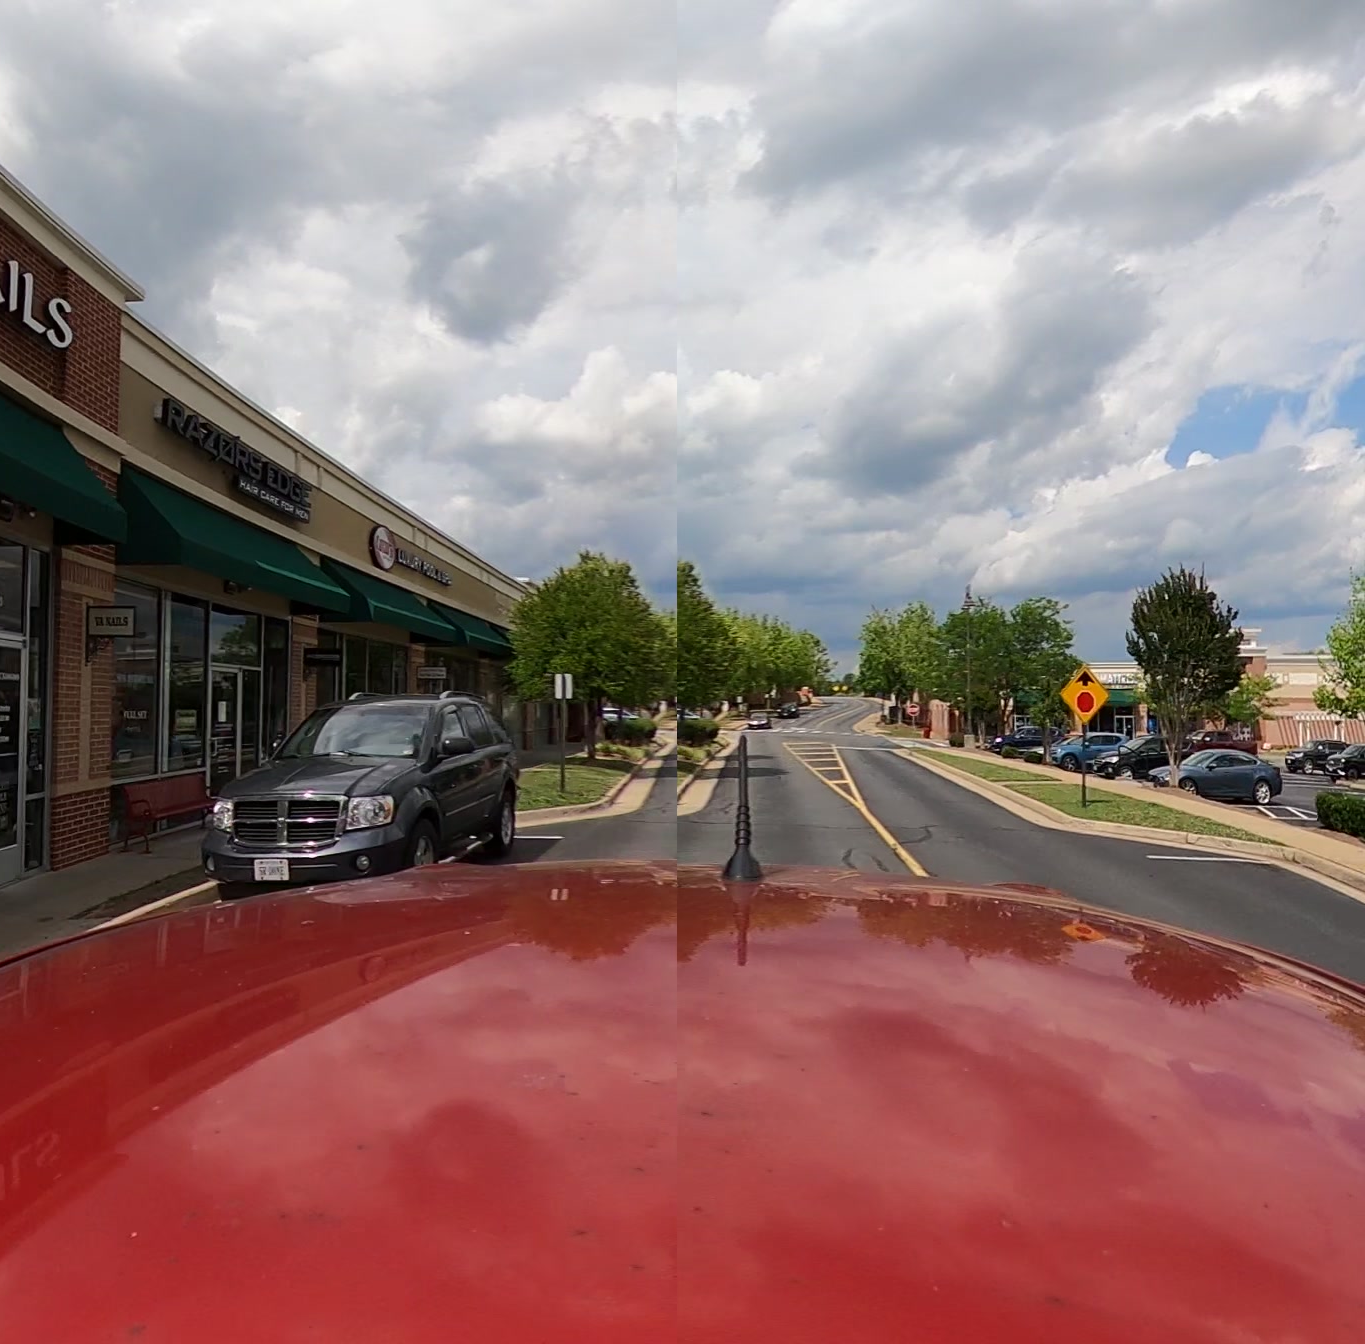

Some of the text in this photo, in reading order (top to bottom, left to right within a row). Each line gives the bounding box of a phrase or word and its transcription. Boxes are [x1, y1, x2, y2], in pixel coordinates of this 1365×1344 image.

[239, 479, 310, 521] HAIR CARE FOR MEN
[266, 463, 313, 508] EDGE
[105, 616, 129, 627] NAILS
